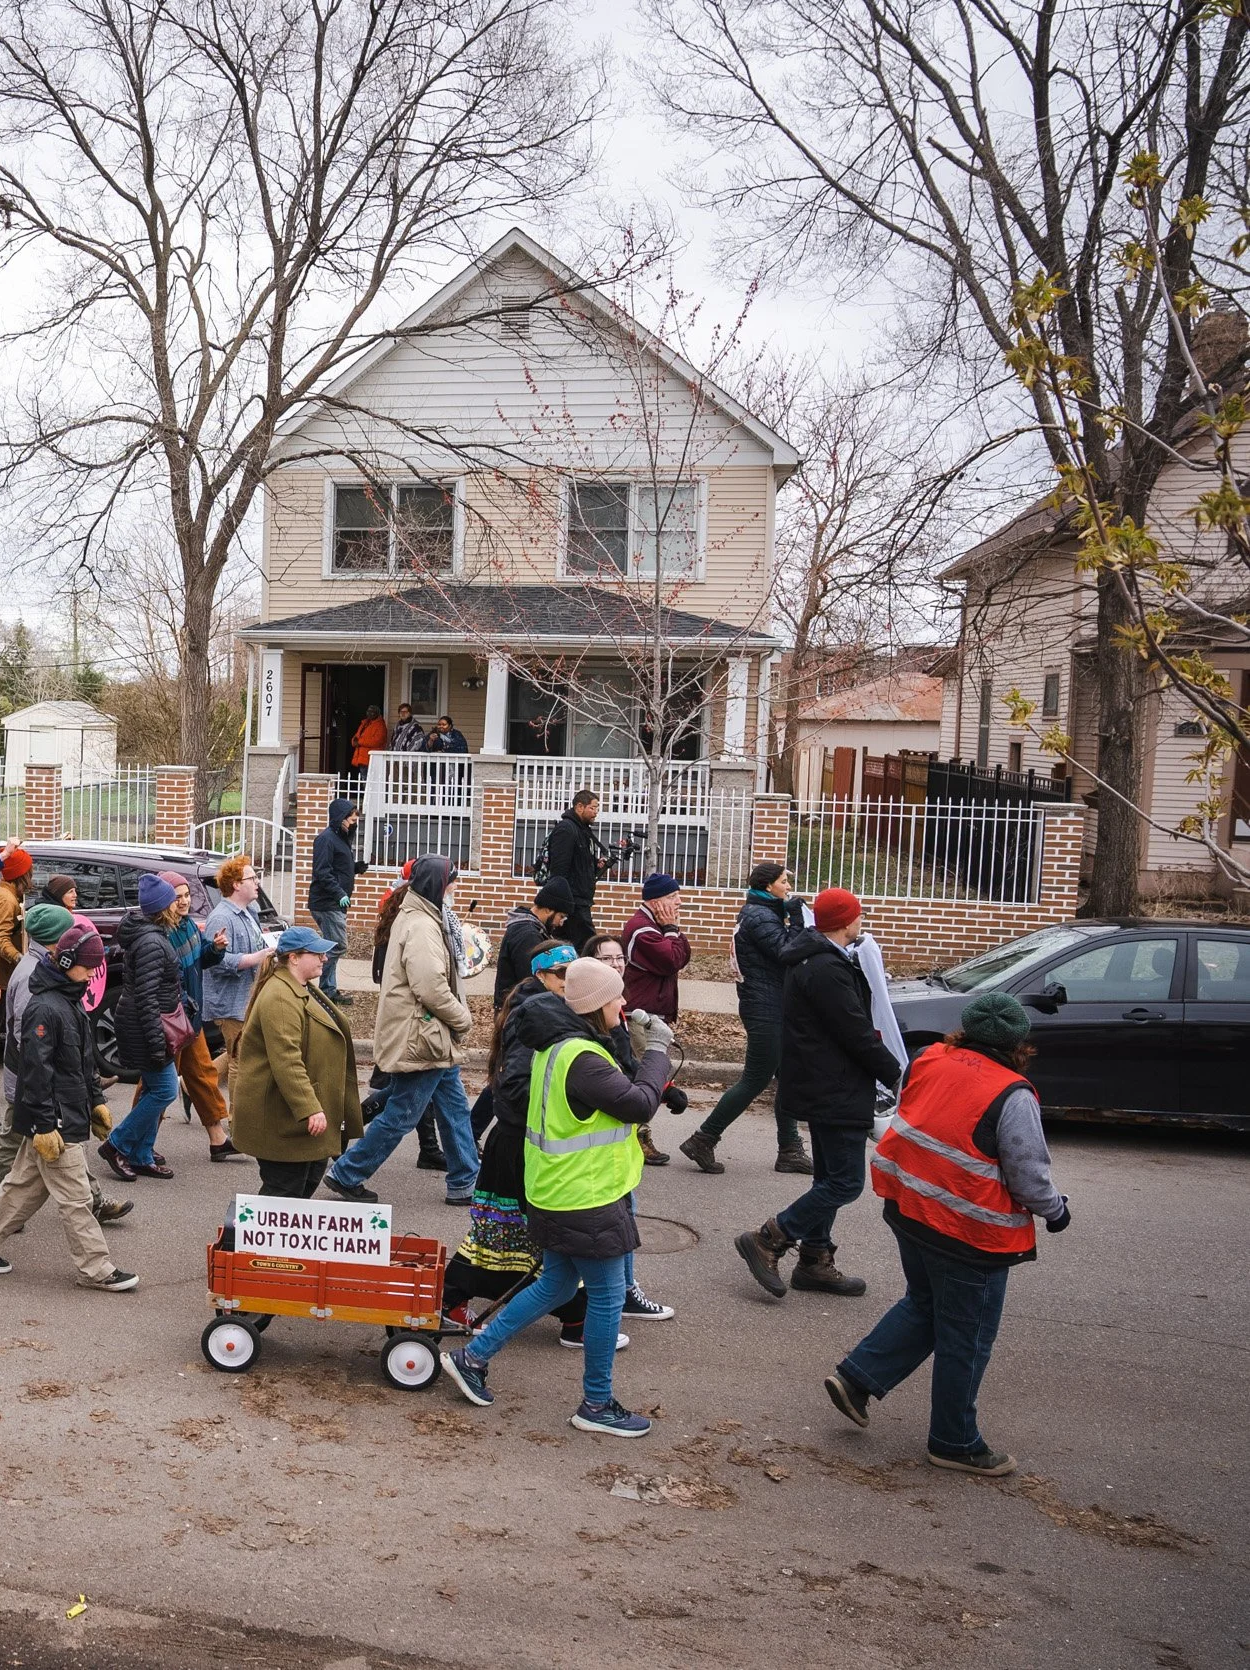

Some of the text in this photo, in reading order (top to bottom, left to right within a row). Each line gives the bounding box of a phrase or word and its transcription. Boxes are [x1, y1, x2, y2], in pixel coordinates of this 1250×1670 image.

[265, 669, 273, 717] 2607
[257, 1210, 363, 1233] URBAN FARM
[243, 1230, 381, 1255] NOT TOXIC HARM
